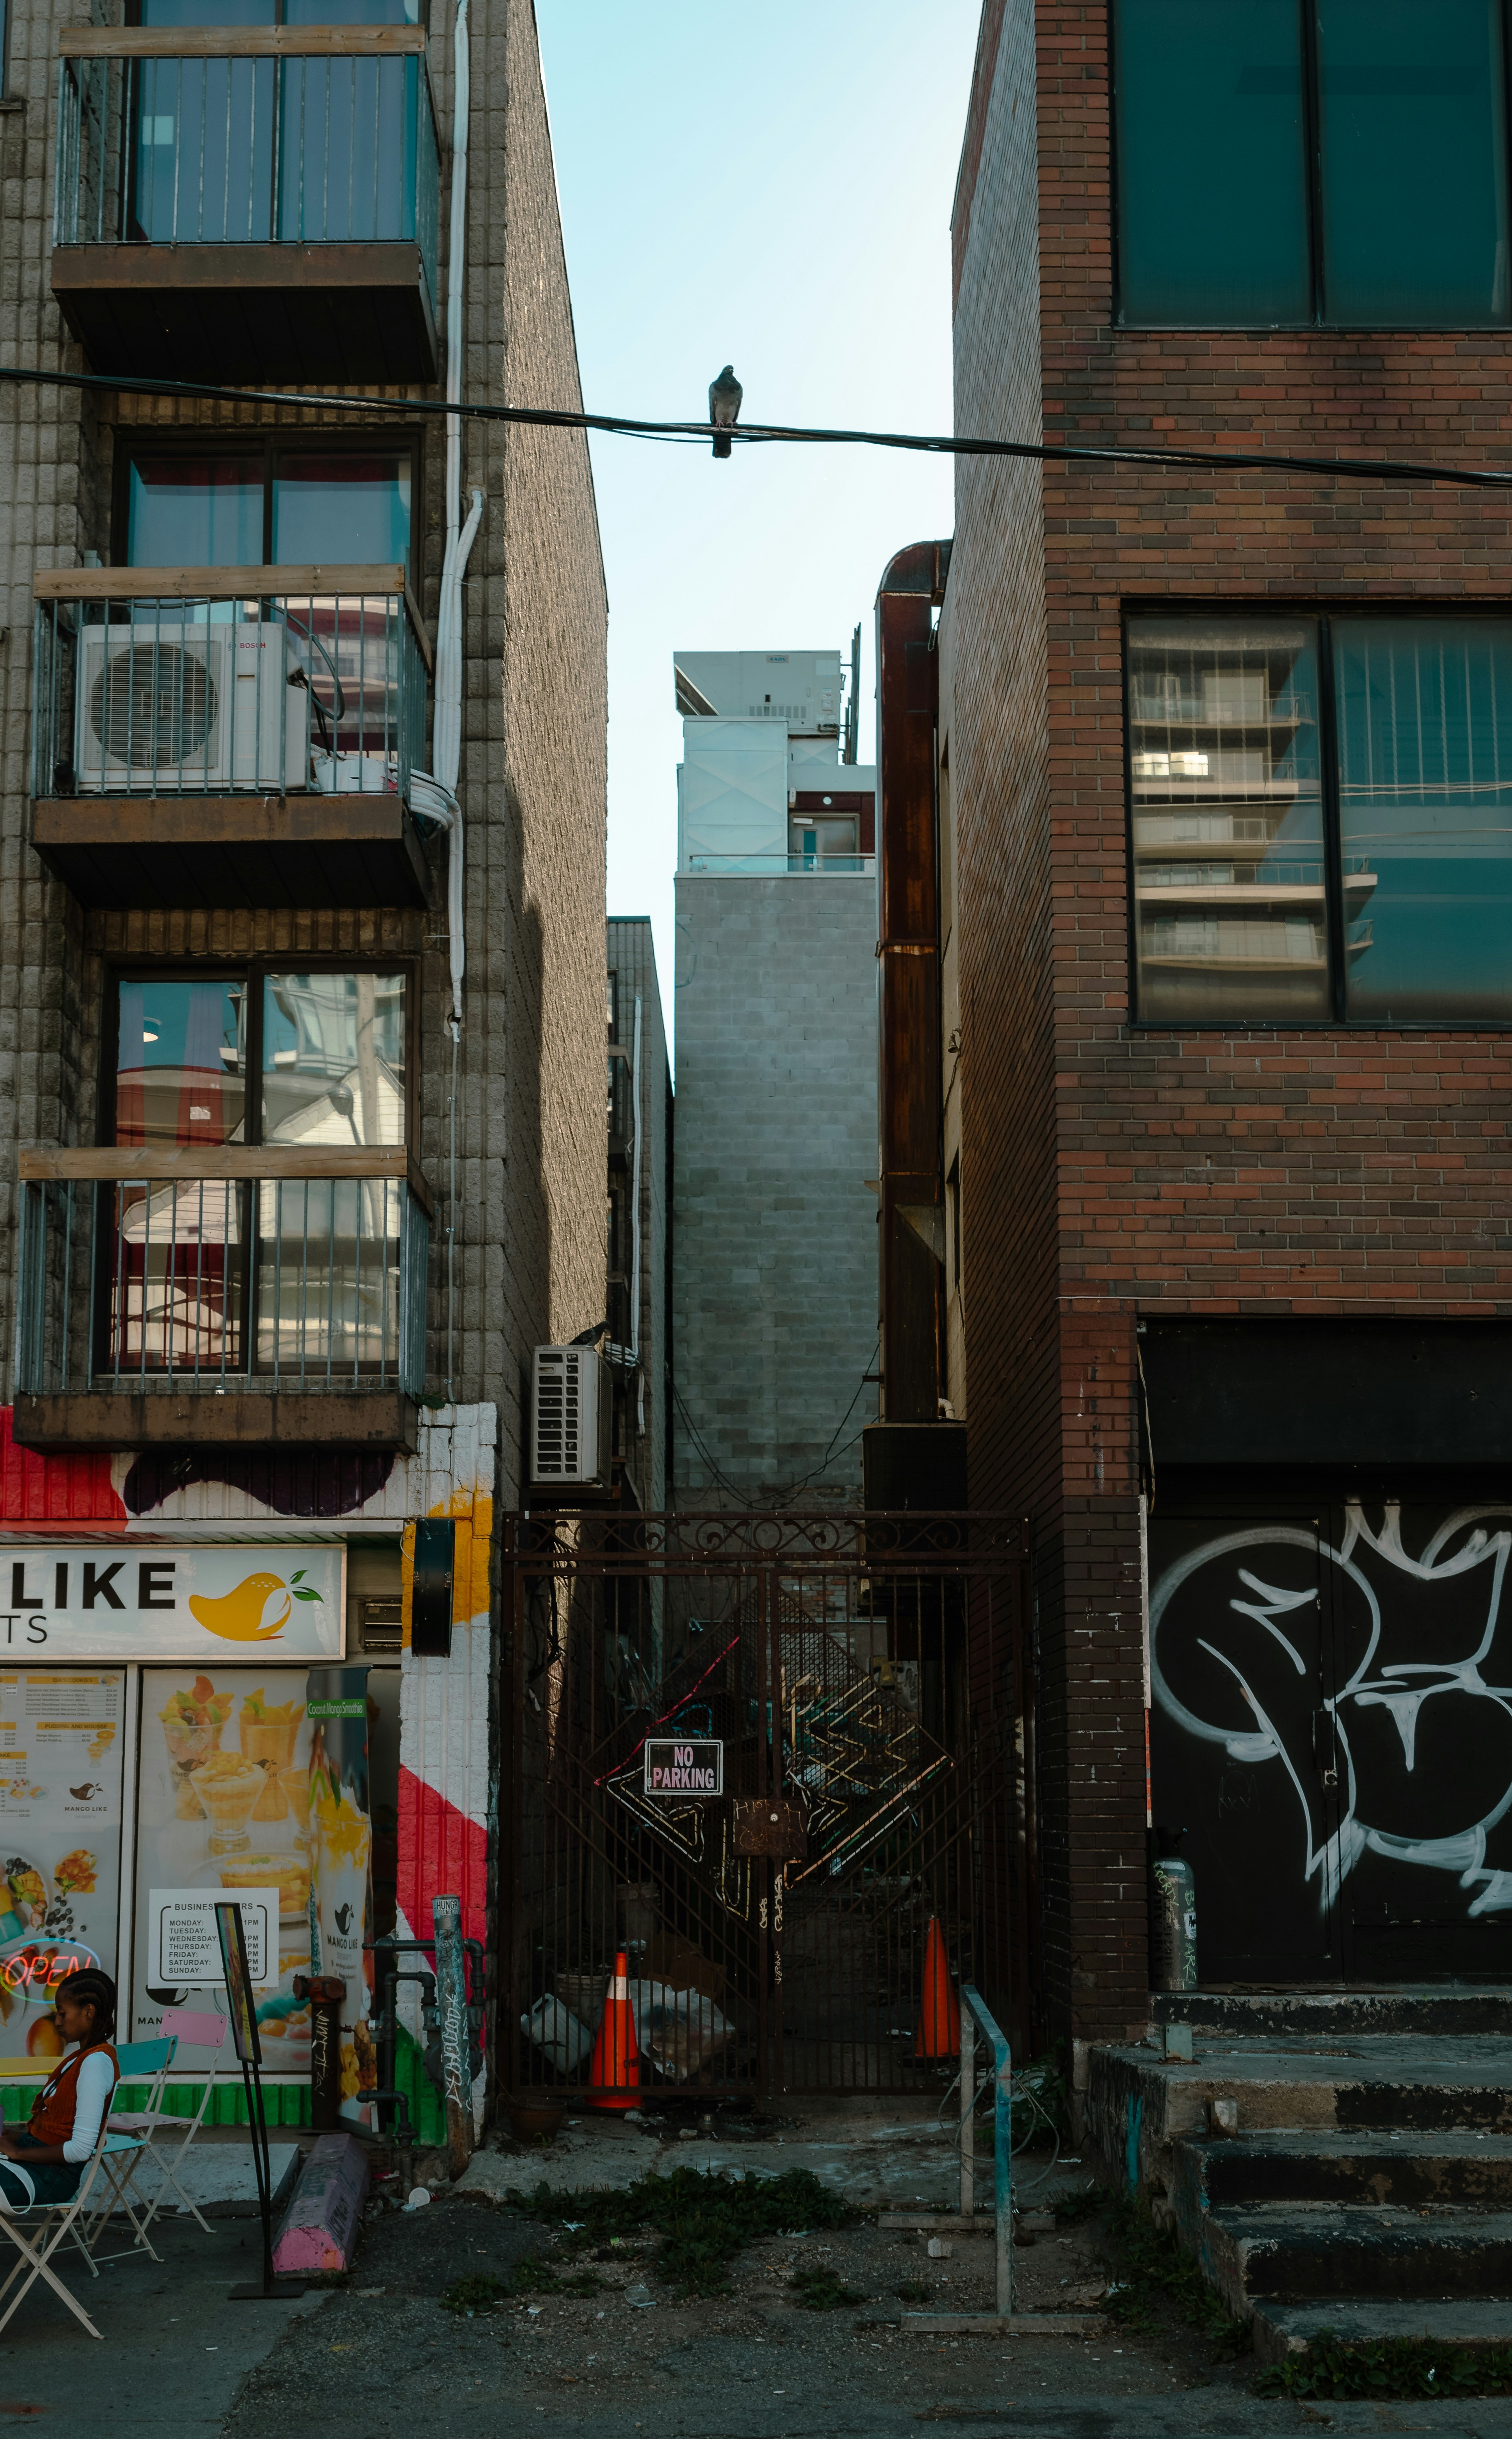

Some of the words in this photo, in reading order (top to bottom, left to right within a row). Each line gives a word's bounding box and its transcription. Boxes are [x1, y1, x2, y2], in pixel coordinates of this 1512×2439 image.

[11, 1562, 175, 1609] LIKE
[308, 1703, 325, 1714] Coconut
[326, 1702, 342, 1717] Mango
[342, 1701, 363, 1714] Smoothie
[674, 1746, 693, 1767] NO
[653, 1768, 714, 1788] PARKING
[327, 1934, 347, 1949] MANGO
[349, 1938, 358, 1950] LIKE
[5, 1955, 91, 1987] OPEN
